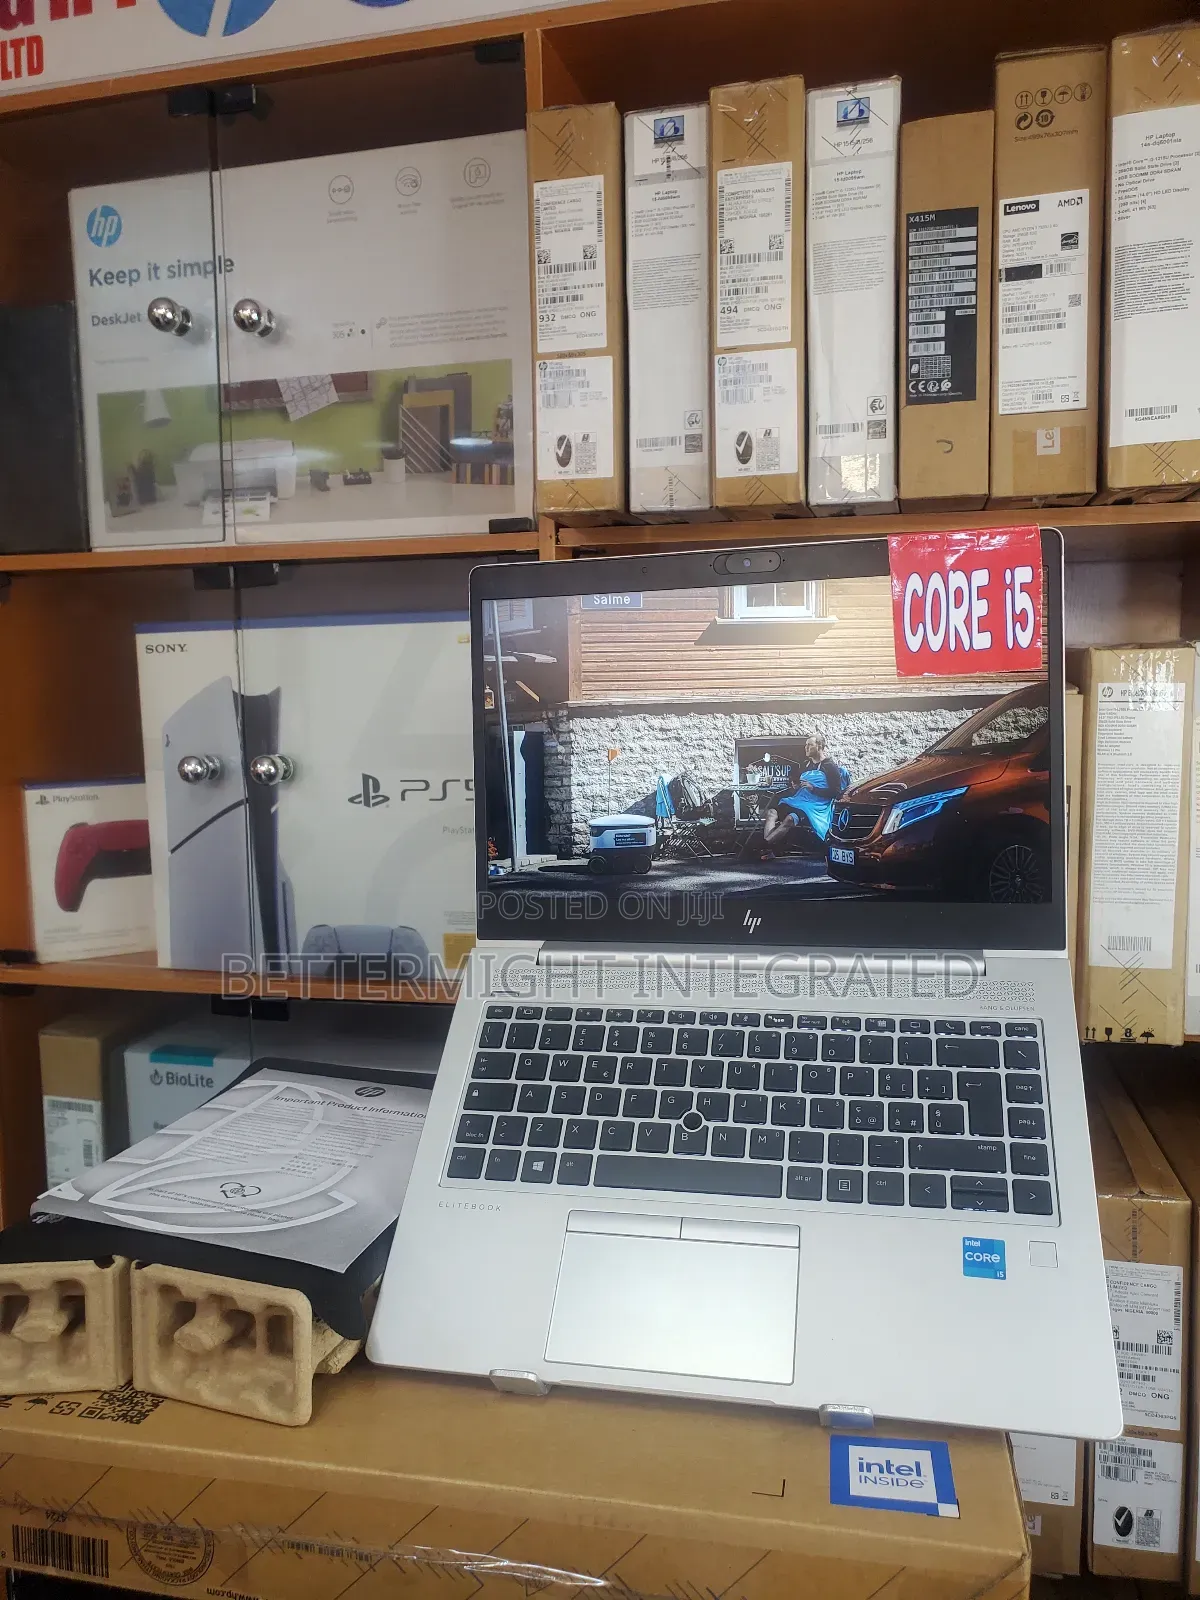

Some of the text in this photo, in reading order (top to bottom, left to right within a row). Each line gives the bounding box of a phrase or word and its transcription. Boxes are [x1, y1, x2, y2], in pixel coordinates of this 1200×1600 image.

[1057, 198, 1076, 207] AMD
[1006, 203, 1036, 213] Lenovo
[909, 214, 936, 223] X415M
[87, 205, 122, 247] hp
[89, 255, 235, 287] Keep it simple
[720, 305, 738, 314] 494
[91, 311, 142, 327] DeskJet
[538, 313, 556, 323] 932
[579, 310, 597, 318] ONG
[593, 594, 631, 605] Salme
[903, 565, 1036, 653] CORE i5
[145, 644, 188, 654] SONY
[578, 1038, 584, 1046] 3
[682, 1042, 688, 1050] 6
[718, 1043, 724, 1051] 7
[754, 1045, 761, 1053] 8
[791, 1047, 798, 1055] 9
[524, 1058, 533, 1066] Q
[558, 1059, 569, 1067] W
[626, 1062, 634, 1070] R
[661, 1063, 669, 1071] T
[698, 1065, 706, 1073] Y
[734, 1066, 742, 1074] U
[166, 1071, 214, 1088] BioLite
[847, 1072, 854, 1080] P
[525, 1090, 533, 1098] A
[560, 1091, 567, 1099] S
[630, 1094, 637, 1102] F
[274, 1095, 326, 1107] Important
[327, 1101, 367, 1112] Product
[667, 1096, 675, 1104] G
[740, 1100, 747, 1108] J
[779, 1102, 787, 1110] K
[817, 1105, 824, 1113] L
[536, 1123, 543, 1132] Z
[571, 1125, 579, 1133] X
[607, 1127, 615, 1135] C
[645, 1129, 652, 1137] V
[681, 1133, 689, 1141] B
[719, 1133, 727, 1141] N
[758, 1135, 767, 1143] M
[438, 1200, 502, 1212] ELITEBOOK
[964, 1238, 981, 1247] intel
[1151, 1392, 1170, 1400] ONG
[858, 1456, 922, 1478] intel
